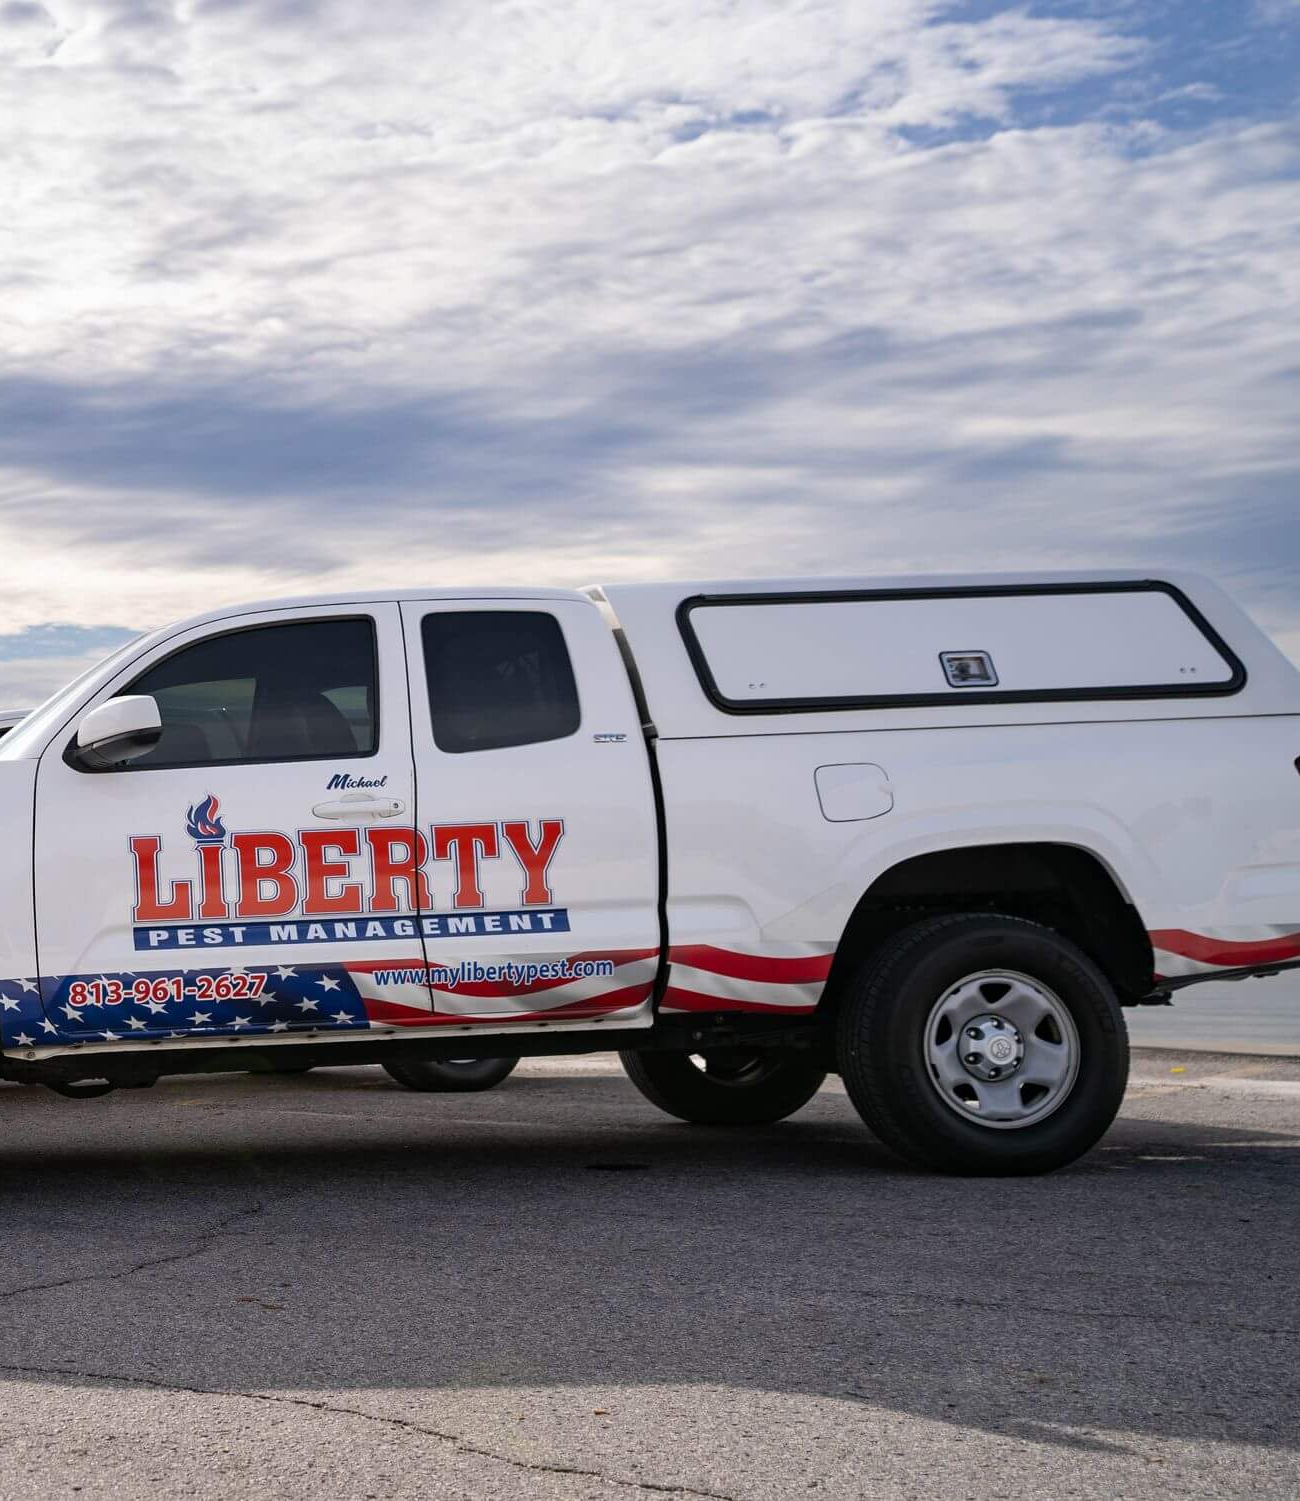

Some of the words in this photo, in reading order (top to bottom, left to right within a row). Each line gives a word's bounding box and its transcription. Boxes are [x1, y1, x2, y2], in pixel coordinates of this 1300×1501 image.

[326, 774, 388, 790] Michael
[129, 819, 565, 923] LIBERTY
[148, 927, 247, 946] PEST
[269, 913, 555, 941] MANAGEMENT
[69, 974, 268, 1006] 813-961-2627
[373, 960, 614, 988] www.mylibertypest.com
